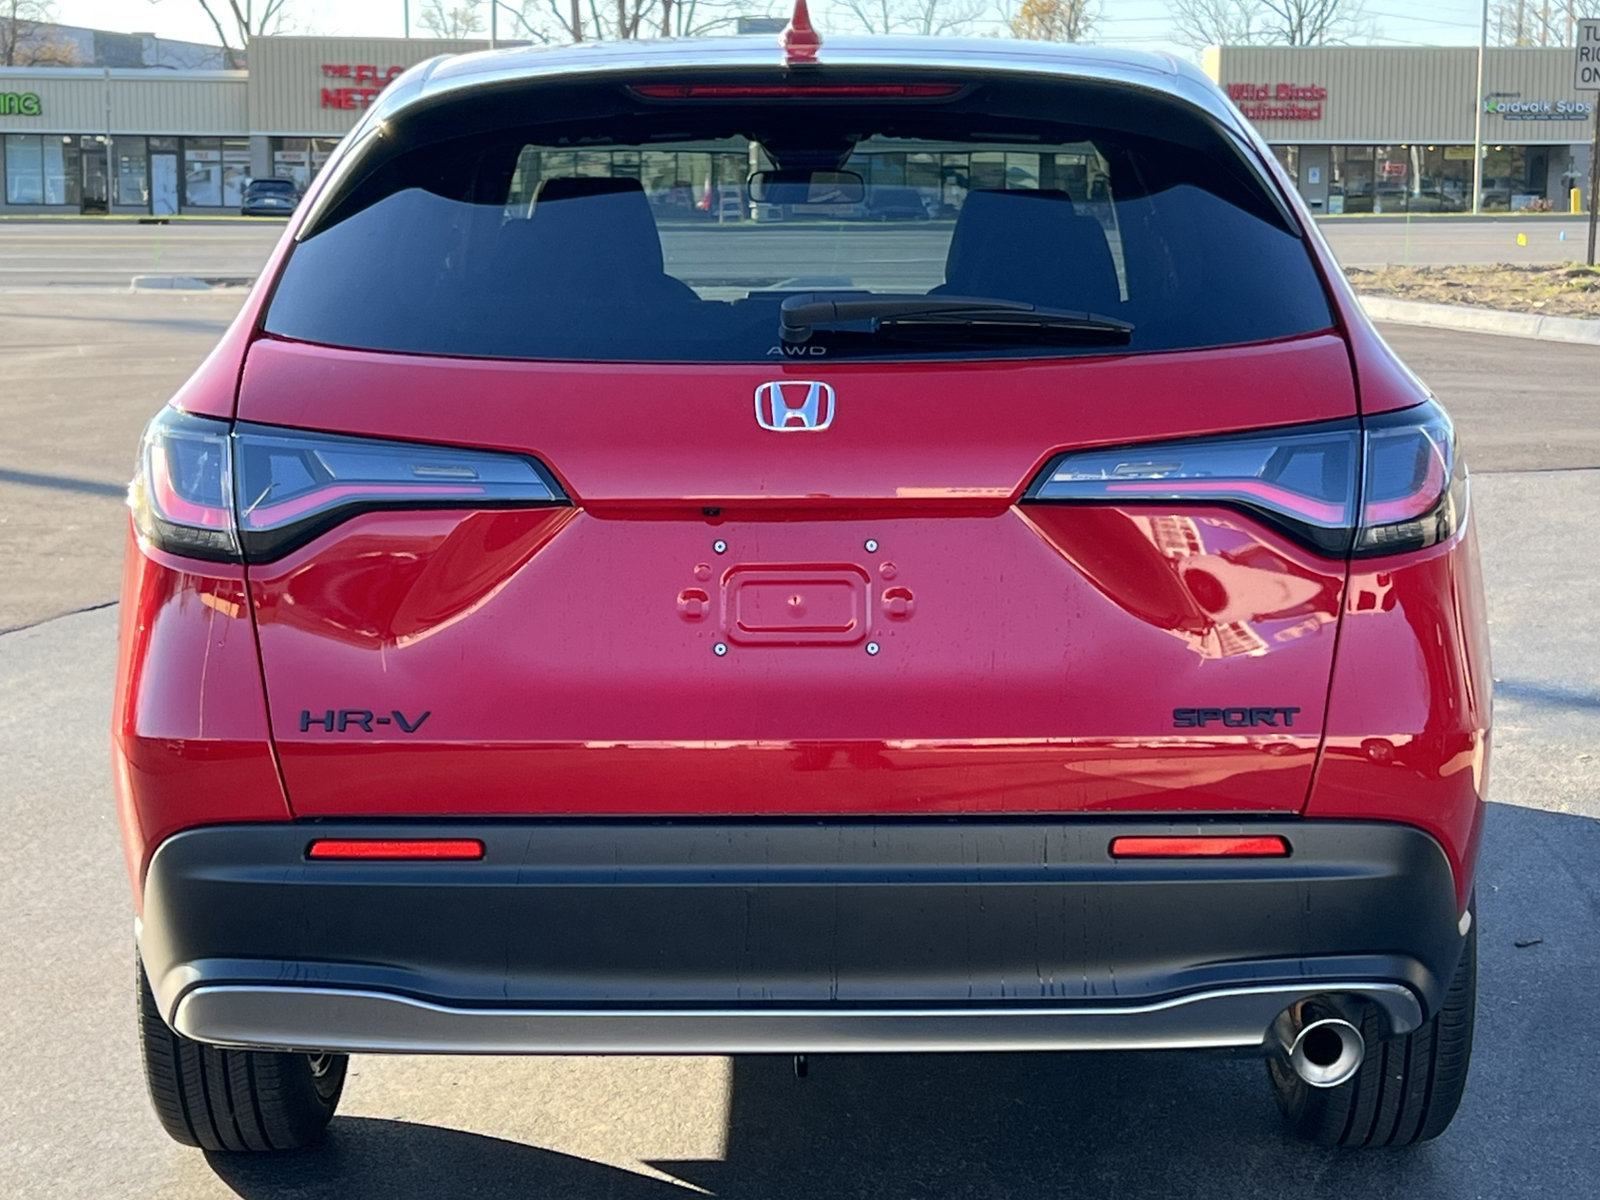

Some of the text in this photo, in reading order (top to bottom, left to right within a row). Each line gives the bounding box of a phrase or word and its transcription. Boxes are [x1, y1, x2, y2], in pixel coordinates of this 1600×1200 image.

[322, 64, 349, 78] THE
[1227, 83, 1327, 101] Wild Birds
[1483, 100, 1593, 113] ardwalk Subs
[766, 346, 827, 355] AWD
[300, 709, 432, 733] HR-V
[1172, 707, 1301, 728] SPORT
